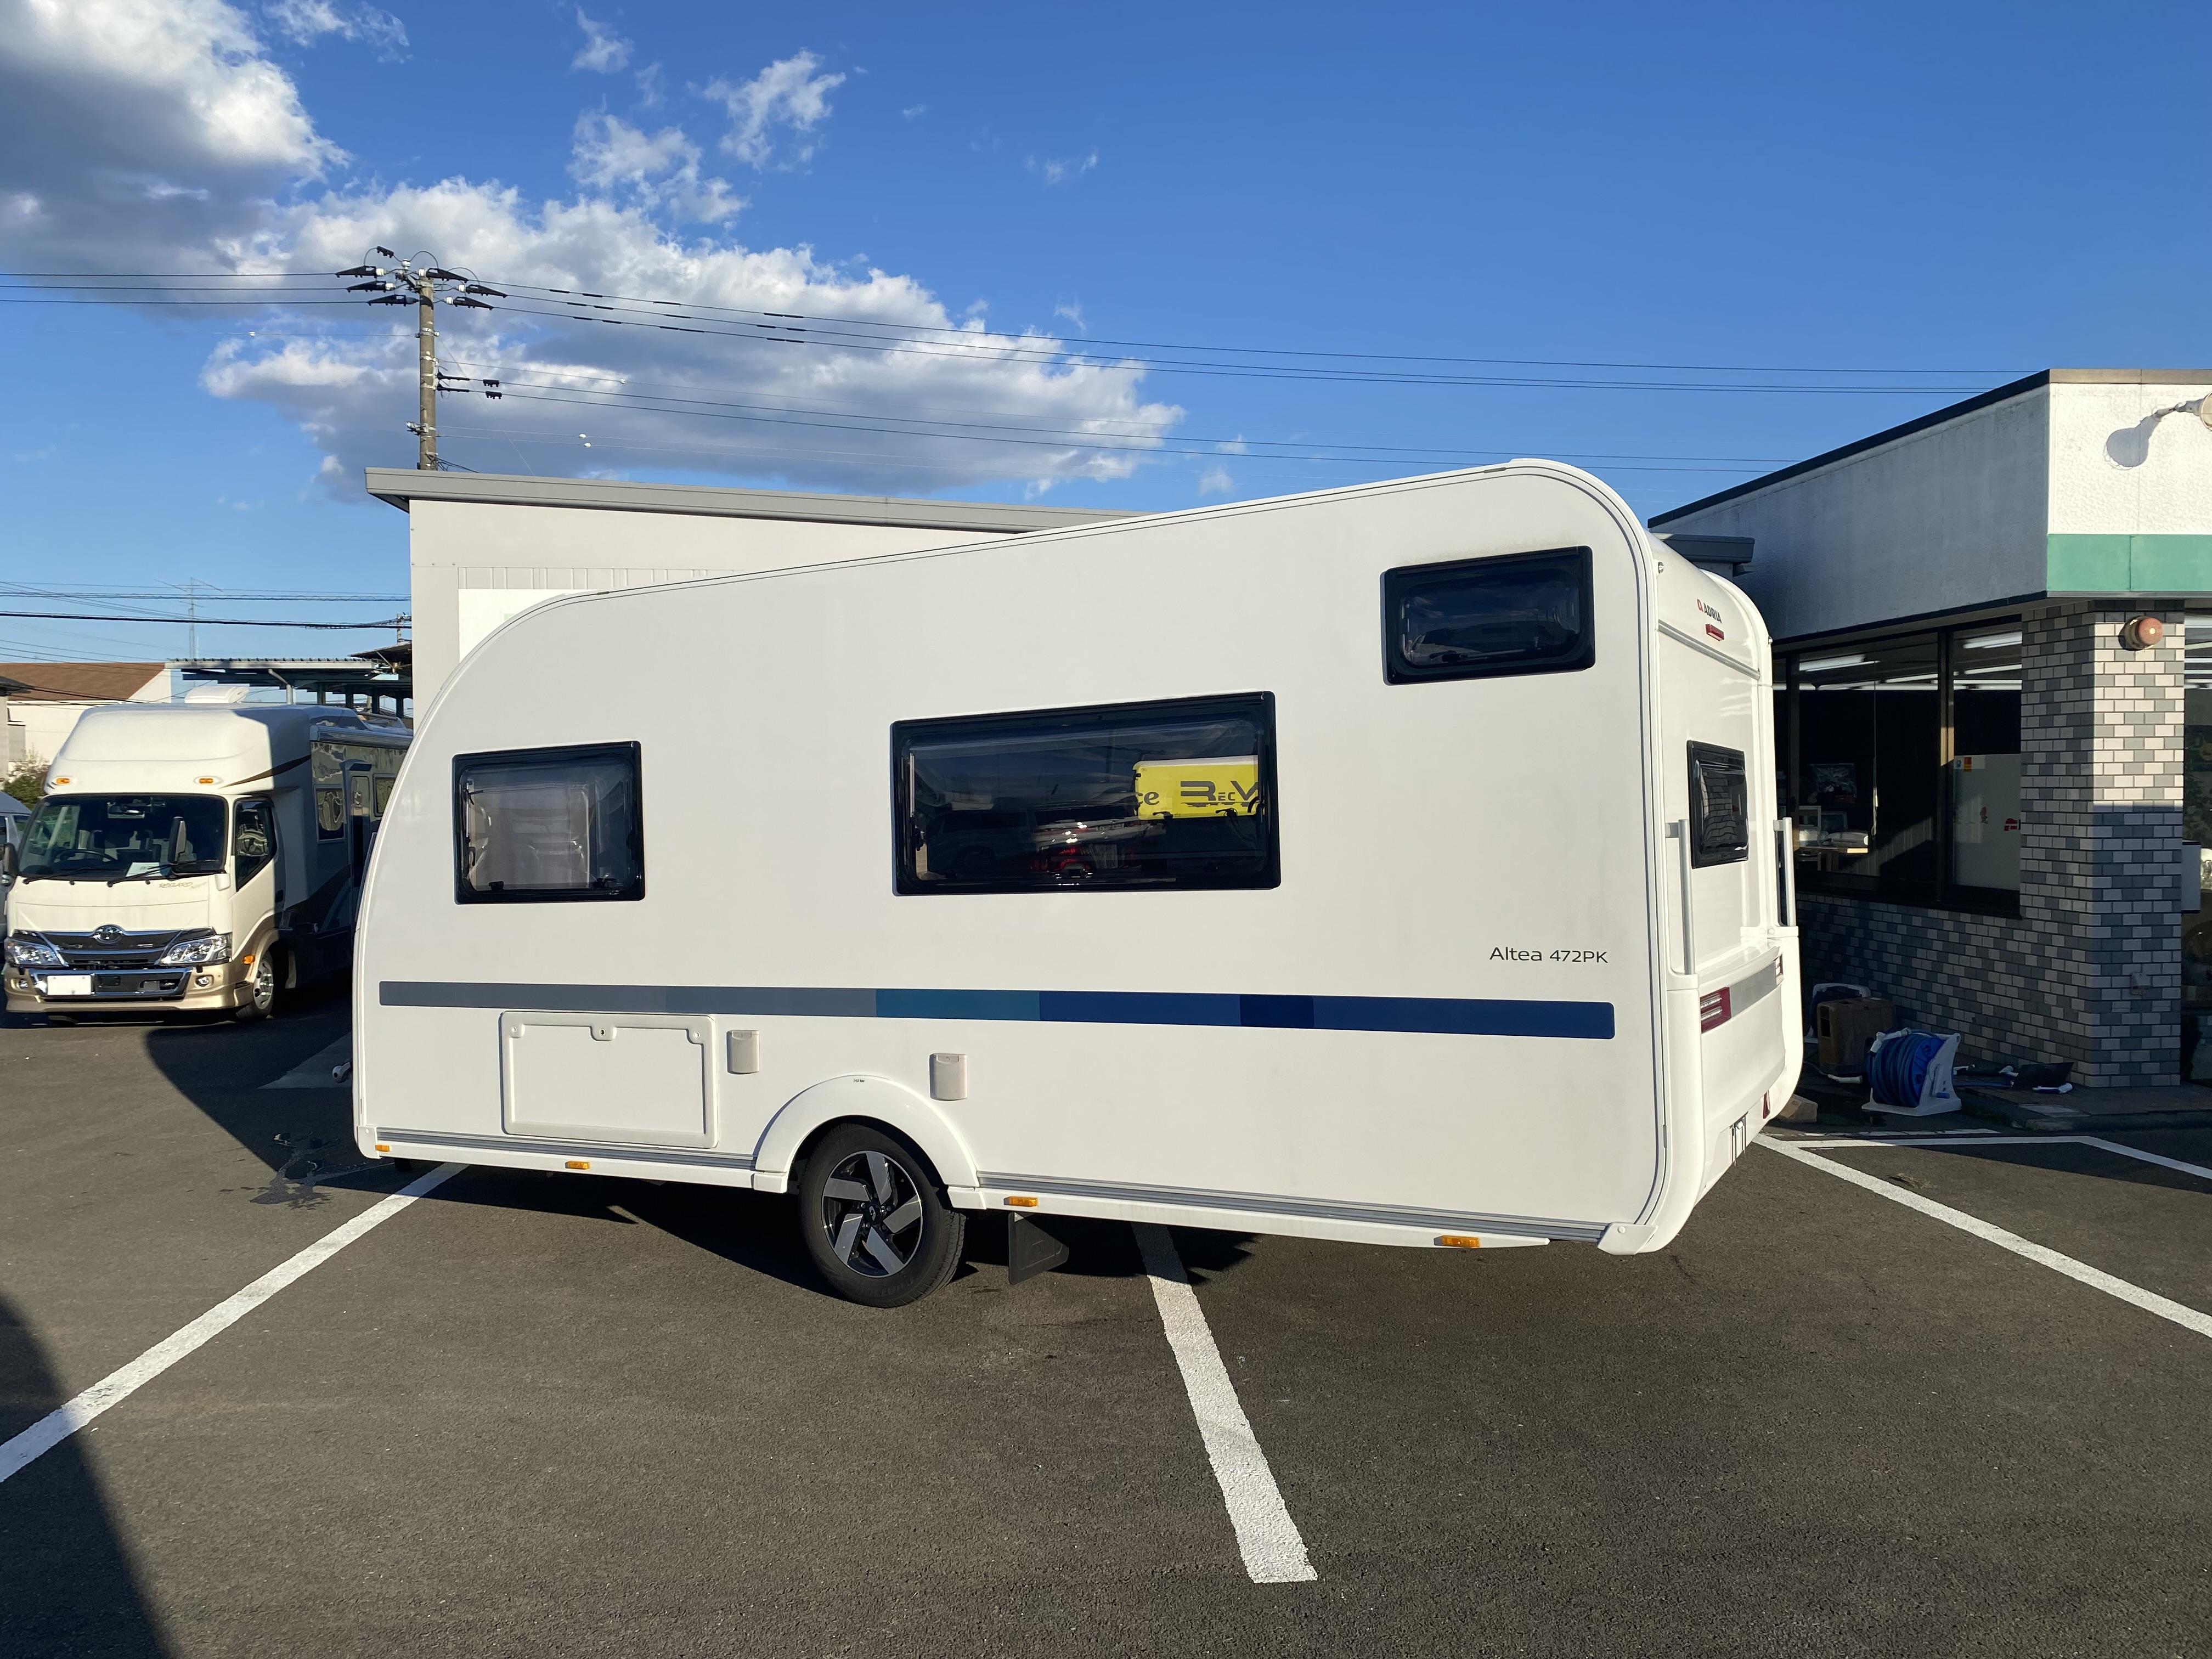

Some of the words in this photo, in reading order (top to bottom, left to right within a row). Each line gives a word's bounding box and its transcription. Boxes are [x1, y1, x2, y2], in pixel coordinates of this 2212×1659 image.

[1703, 602, 1722, 624] ADRIA
[1489, 946, 1542, 961] Altea
[1549, 950, 1609, 963] 472PK
